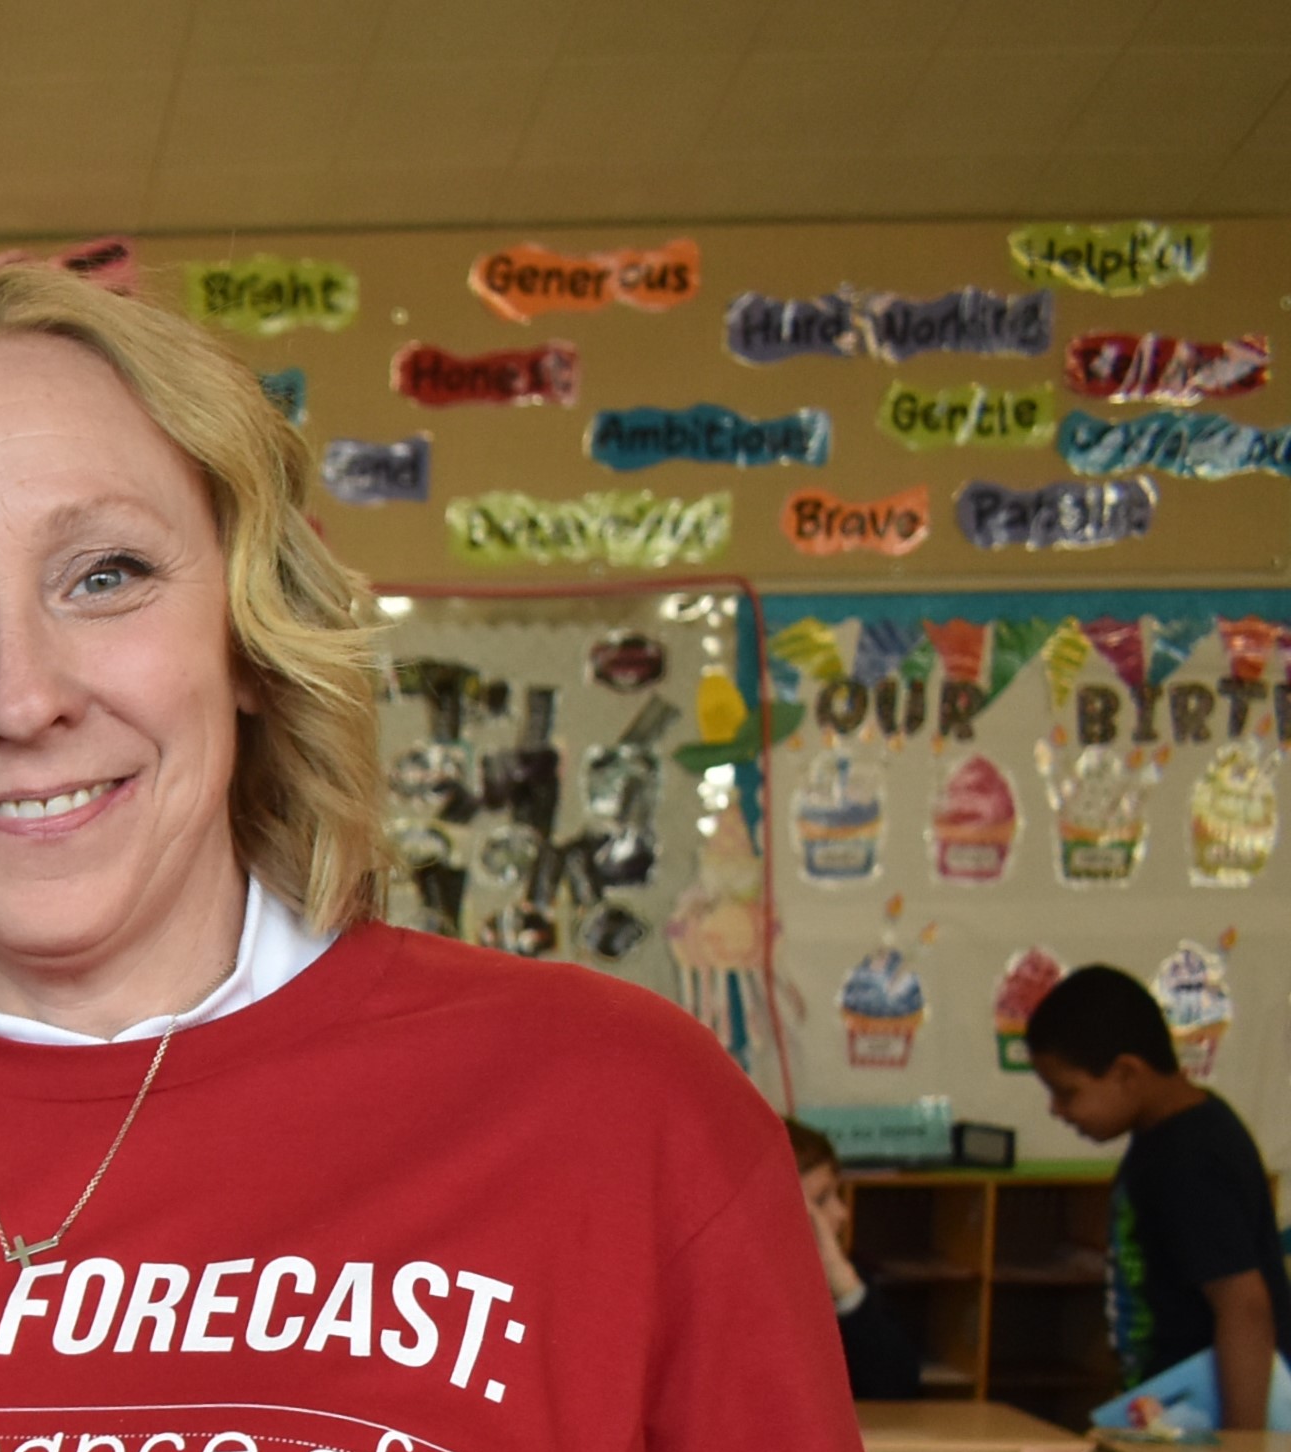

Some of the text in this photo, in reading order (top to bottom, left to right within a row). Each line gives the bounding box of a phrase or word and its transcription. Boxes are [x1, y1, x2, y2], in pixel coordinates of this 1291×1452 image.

[202, 267, 344, 320] Bright
[485, 253, 690, 299] Generous
[794, 498, 921, 541] Brave
[814, 677, 988, 742] OUR
